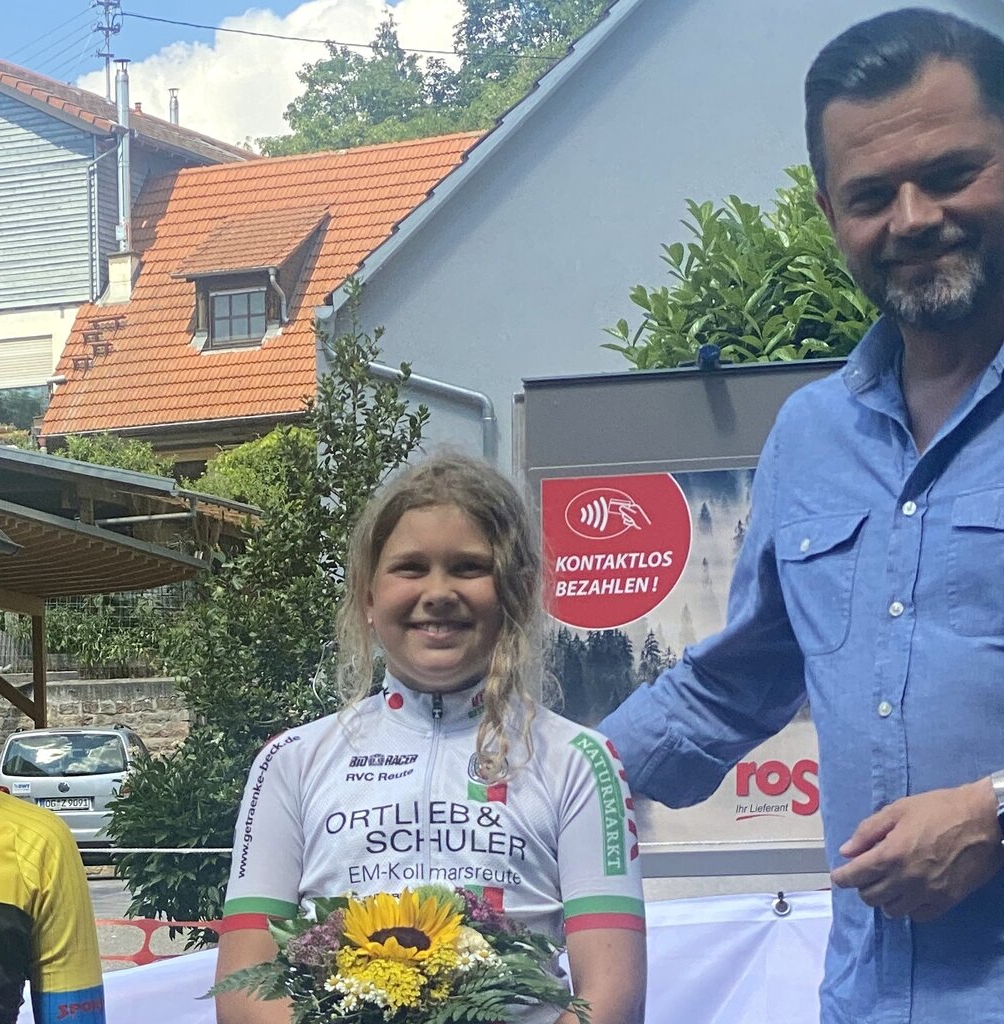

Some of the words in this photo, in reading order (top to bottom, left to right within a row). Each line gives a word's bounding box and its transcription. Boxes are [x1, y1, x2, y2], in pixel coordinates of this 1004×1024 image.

[556, 551, 674, 573] KONTAKTLOS
[556, 577, 650, 597] BEZAHLEN
[345, 772, 375, 782] RVC
[377, 768, 415, 782] Reute
[238, 735, 301, 879] www.getraenke-beck.de
[577, 738, 621, 869] NATURMARKT
[736, 804, 749, 814] Ihr
[749, 803, 789, 813] Lieferant
[325, 801, 470, 835] ORTLIEB
[366, 829, 527, 861] SCHULER
[348, 862, 522, 885] EM-Kollmarsreute
